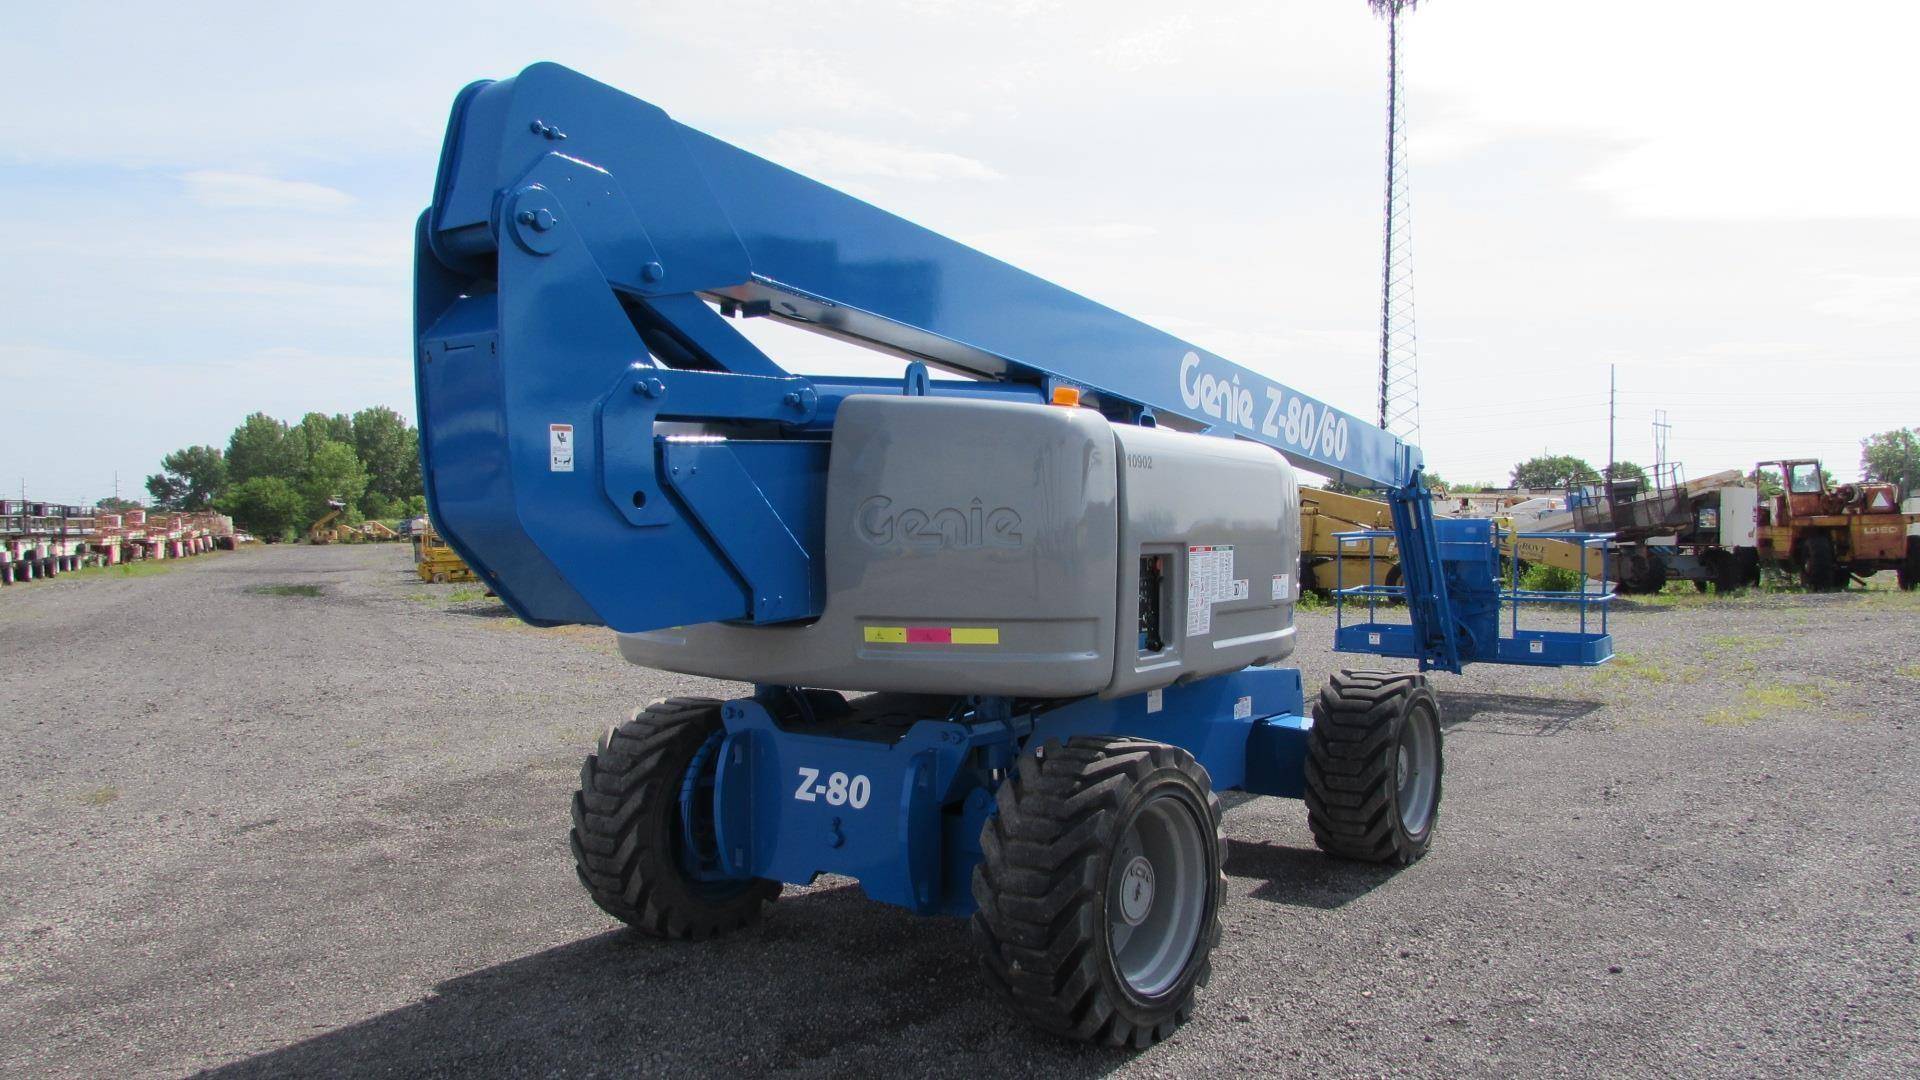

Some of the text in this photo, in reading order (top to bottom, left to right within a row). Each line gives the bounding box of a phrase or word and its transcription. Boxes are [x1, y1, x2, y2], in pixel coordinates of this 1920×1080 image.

[1180, 351, 1348, 461] Genie Z-80/60
[1128, 454, 1152, 469] 10902
[855, 495, 1023, 546] Genie
[795, 767, 871, 809] Z-80
